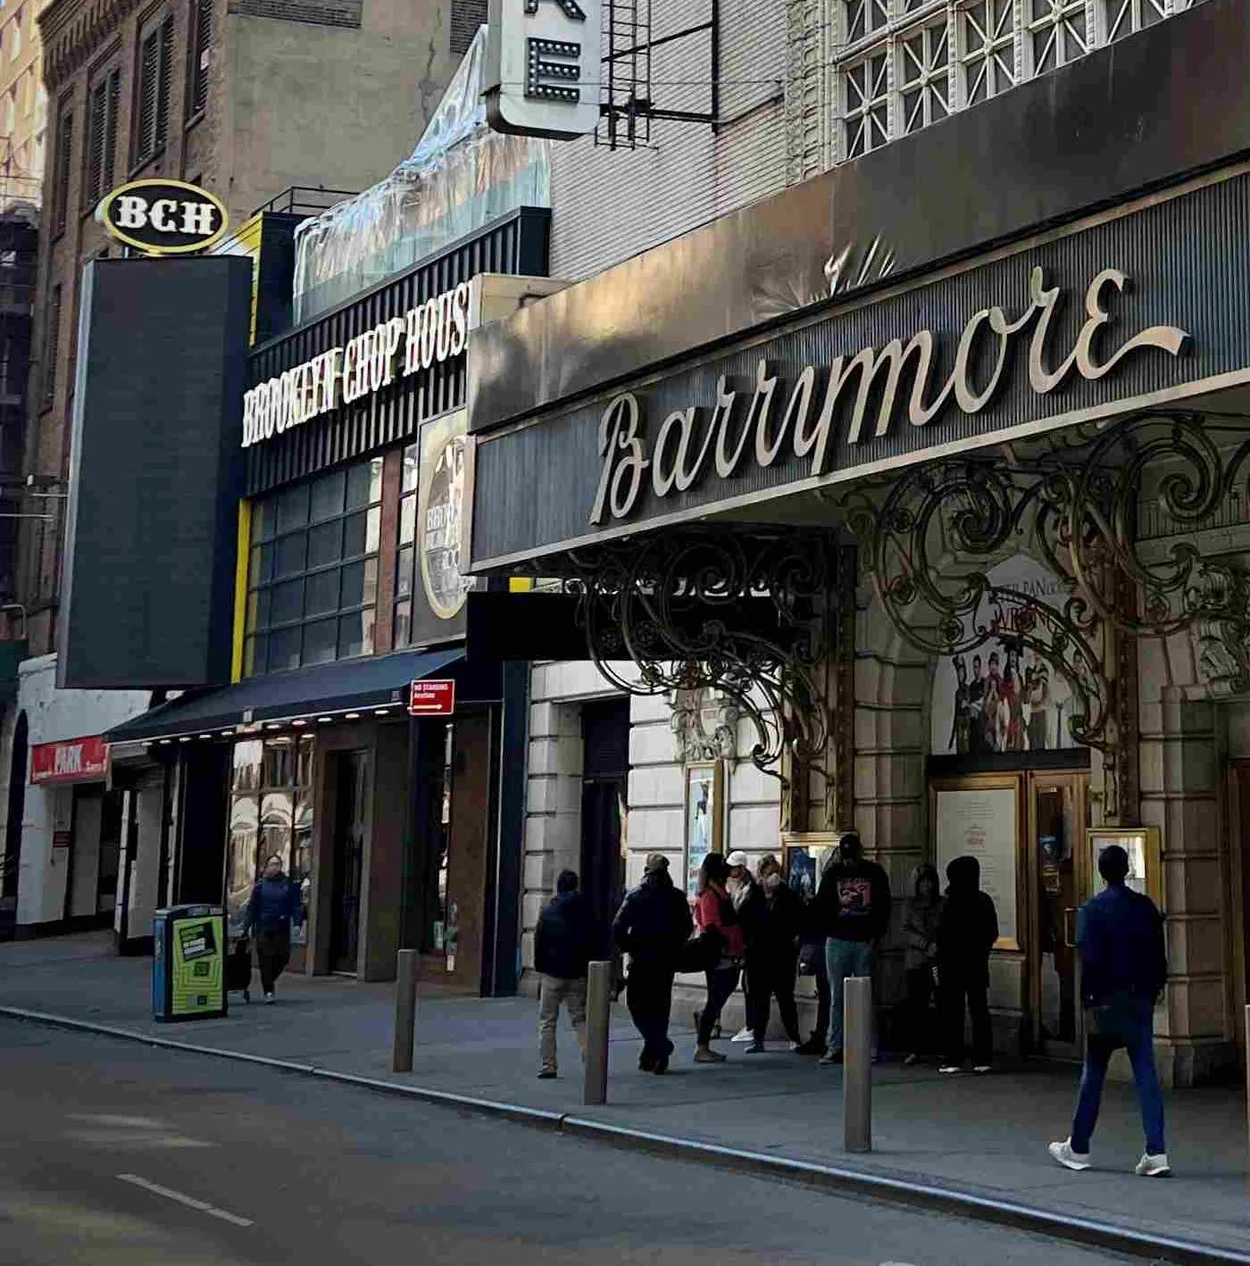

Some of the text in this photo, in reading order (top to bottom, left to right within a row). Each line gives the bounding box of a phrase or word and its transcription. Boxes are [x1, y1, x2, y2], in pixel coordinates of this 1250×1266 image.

[241, 282, 472, 448] BROOKLYN CHOP HOUS
[588, 266, 1194, 528] Barrymore
